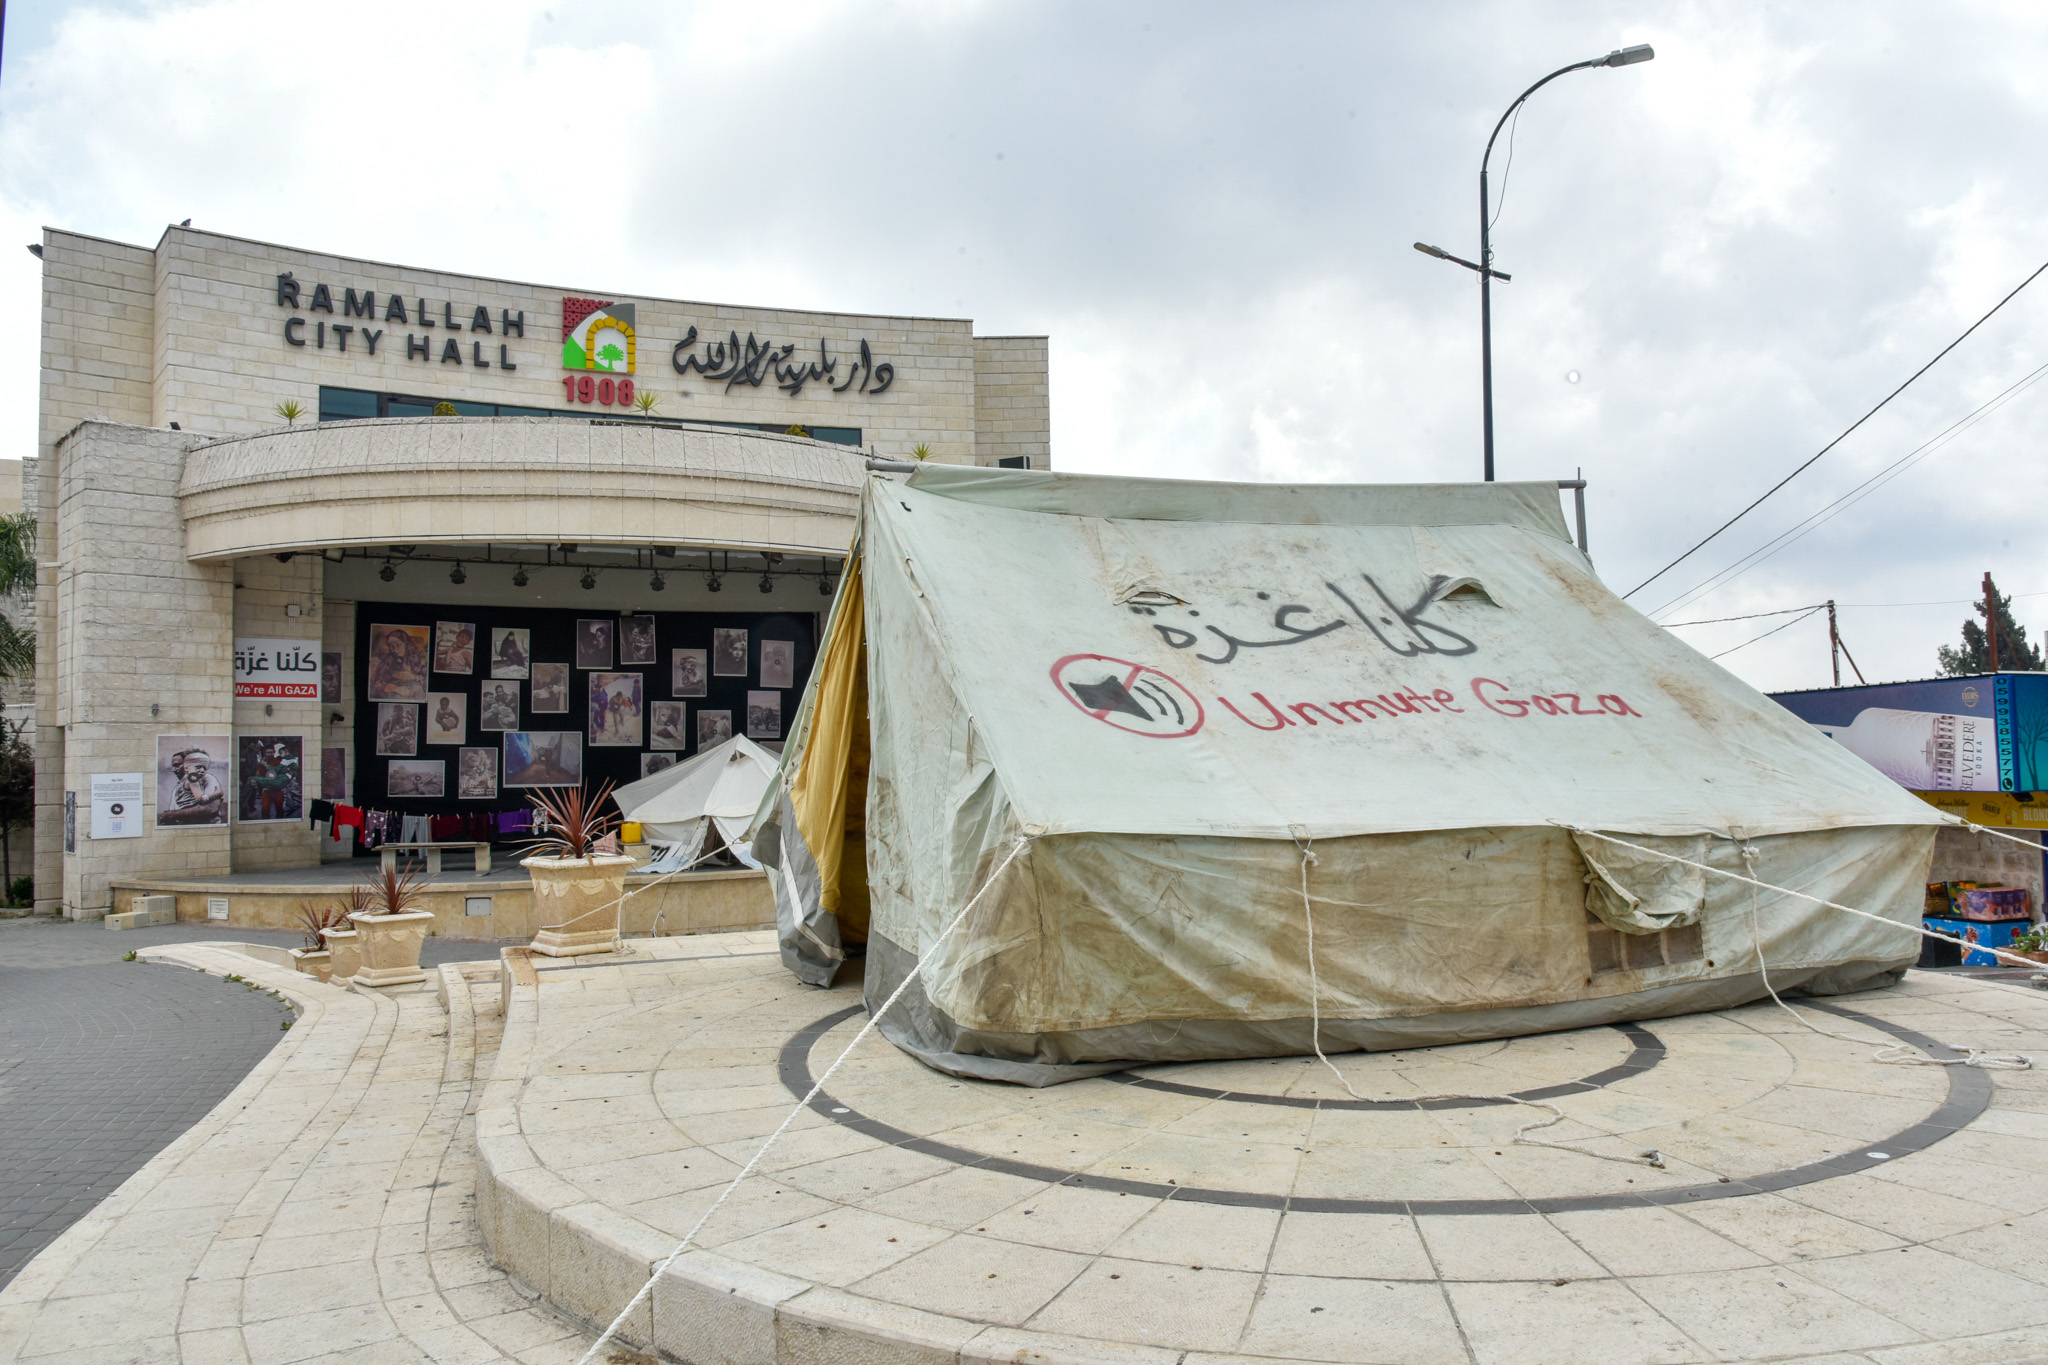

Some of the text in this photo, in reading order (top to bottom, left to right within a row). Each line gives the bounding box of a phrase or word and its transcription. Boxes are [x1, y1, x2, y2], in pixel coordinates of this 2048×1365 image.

[277, 275, 525, 338] RAMALLAH
[284, 317, 517, 370] CITY HALL
[832, 337, 895, 394] دار
[562, 375, 635, 407] 1908
[267, 685, 282, 695] All
[284, 685, 316, 696] GAZA
[1217, 676, 1643, 731] Unmute Gaza
[1960, 720, 1976, 791] BELVEDERE
[1975, 740, 1983, 776] VODKA
